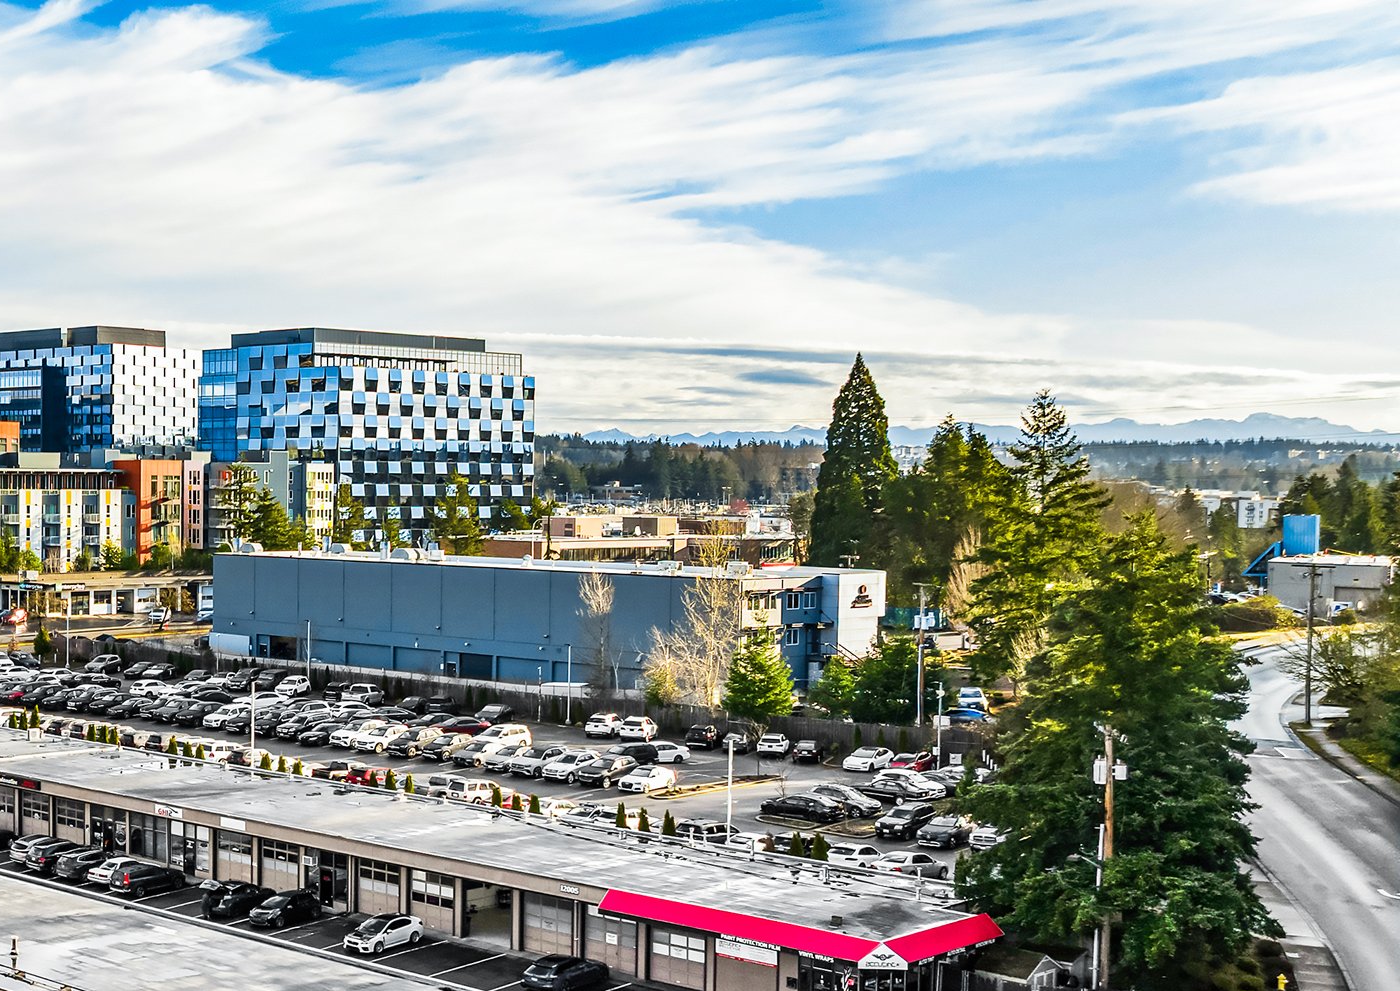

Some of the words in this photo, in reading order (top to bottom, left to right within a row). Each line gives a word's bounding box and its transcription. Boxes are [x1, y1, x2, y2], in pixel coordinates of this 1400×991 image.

[560, 885, 579, 895] 12005
[736, 935, 768, 949] PROTECTION
[768, 943, 781, 951] FILM
[798, 950, 814, 960] VINYL
[815, 954, 834, 964] WRAPS
